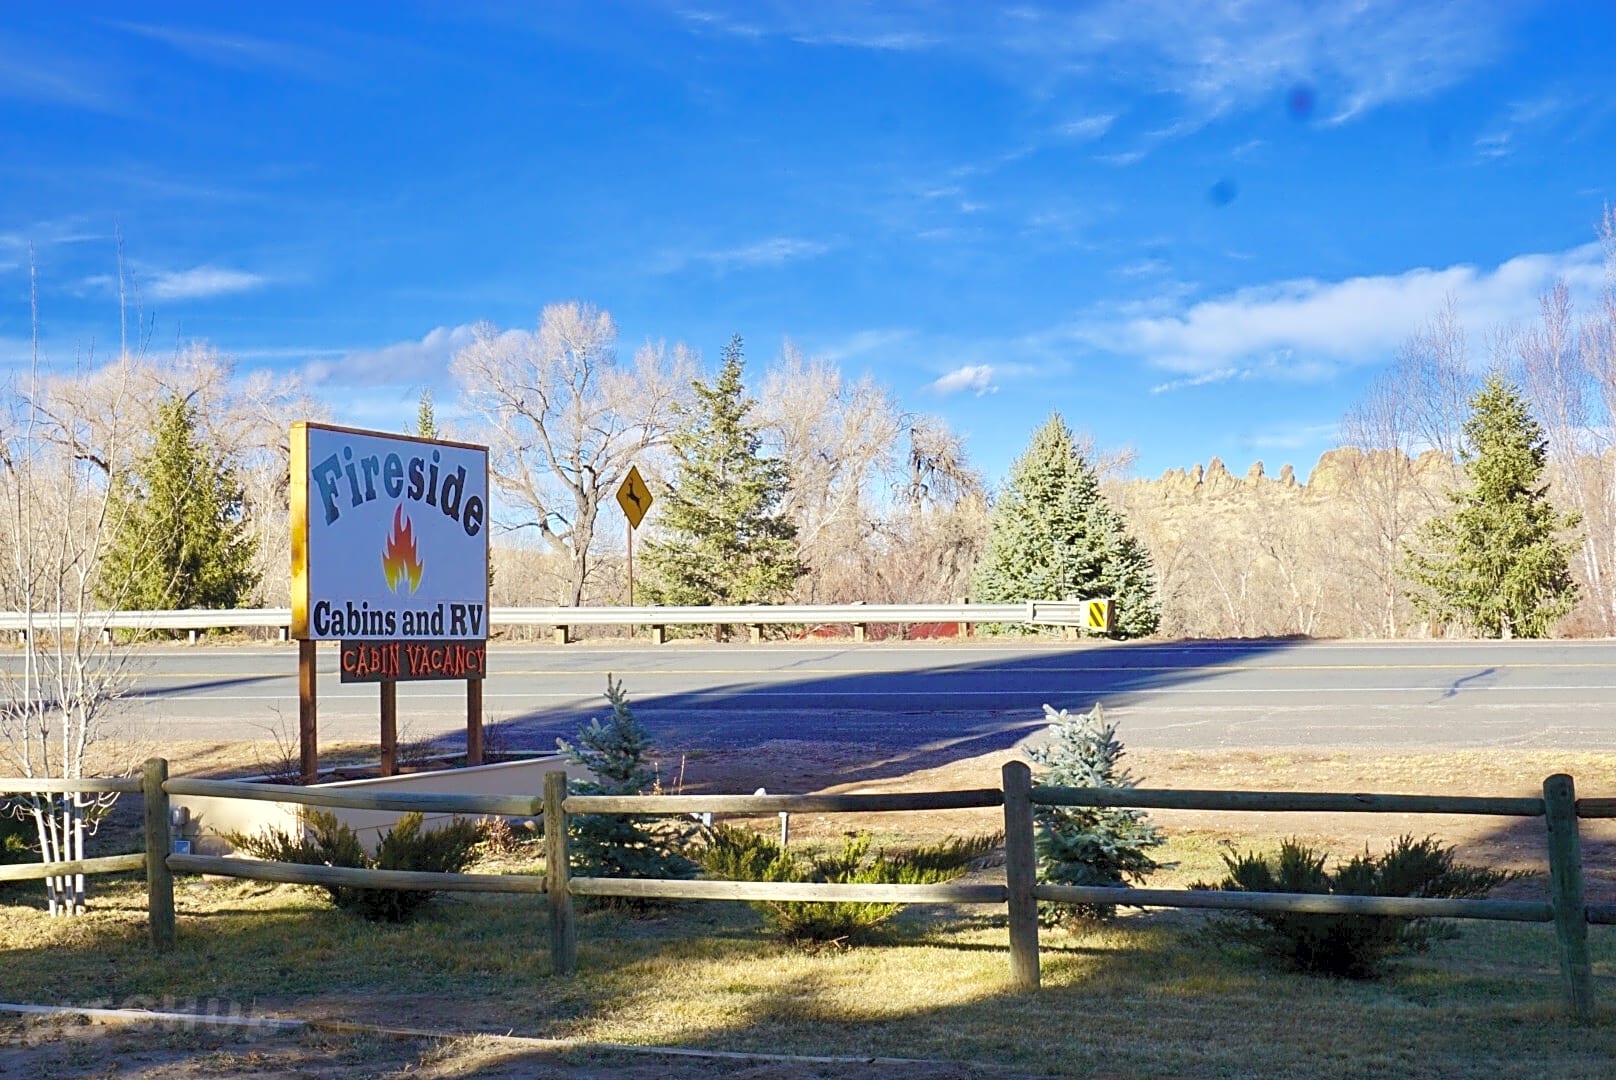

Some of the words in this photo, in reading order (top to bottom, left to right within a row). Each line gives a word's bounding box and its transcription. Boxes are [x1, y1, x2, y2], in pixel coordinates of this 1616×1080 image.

[312, 446, 484, 537] Fireside
[313, 600, 396, 636] Cabins
[402, 603, 444, 636] and
[450, 604, 483, 636] RV
[343, 643, 400, 677] CABIN
[406, 643, 485, 677] VACANCY
